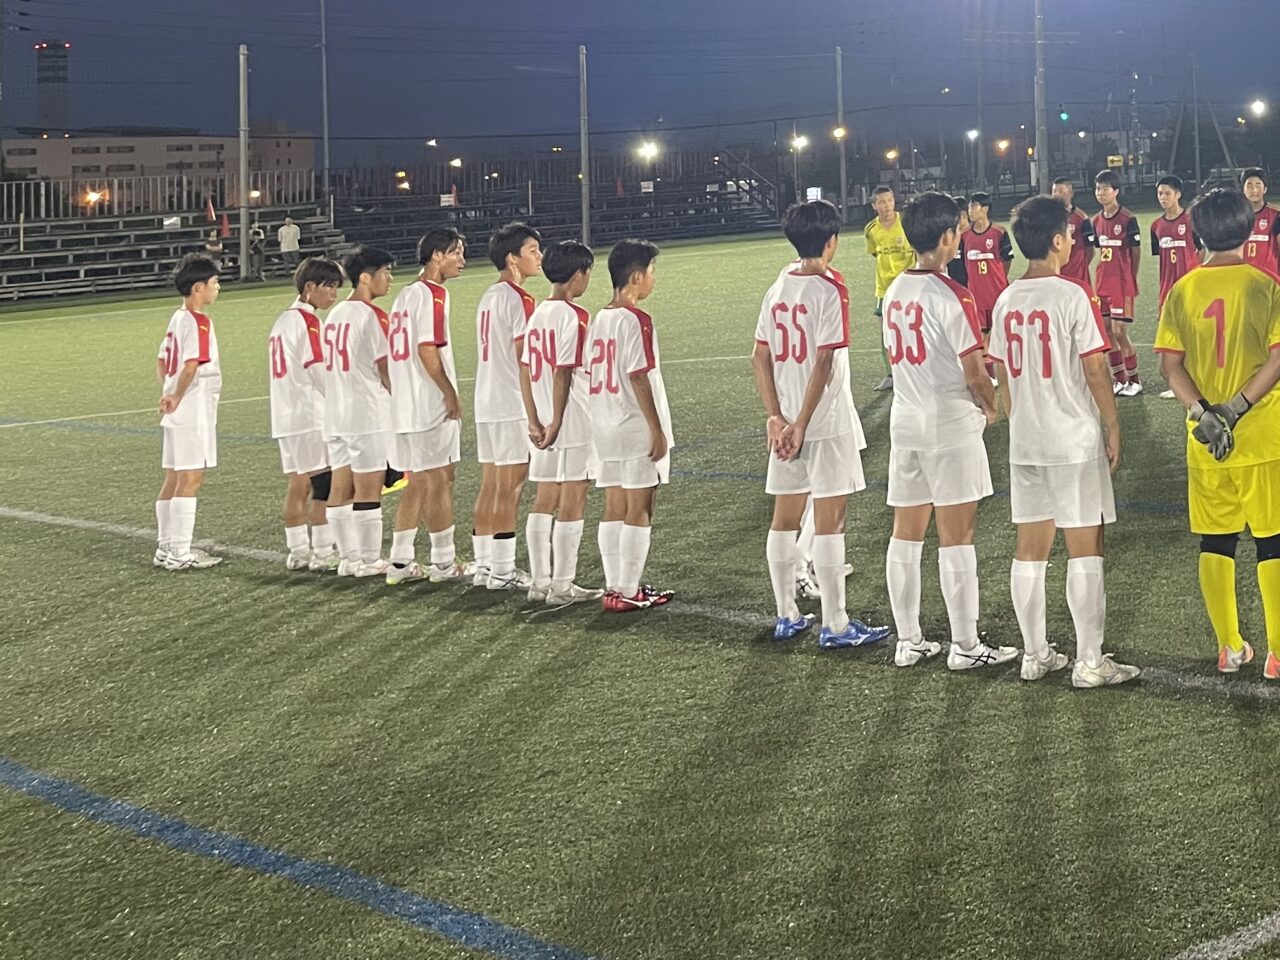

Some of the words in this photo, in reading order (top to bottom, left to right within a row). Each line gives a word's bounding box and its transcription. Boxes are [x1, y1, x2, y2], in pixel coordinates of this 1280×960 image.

[977, 260, 988, 275] 19
[1101, 247, 1113, 262] 29
[1170, 249, 1177, 264] 6
[1247, 242, 1257, 258] 13
[324, 322, 351, 372] 54
[528, 327, 556, 383] 64
[771, 301, 808, 365] 55
[887, 300, 927, 366] 53
[1004, 309, 1052, 379] 67
[1203, 297, 1226, 369] 1
[589, 337, 620, 395] 20
